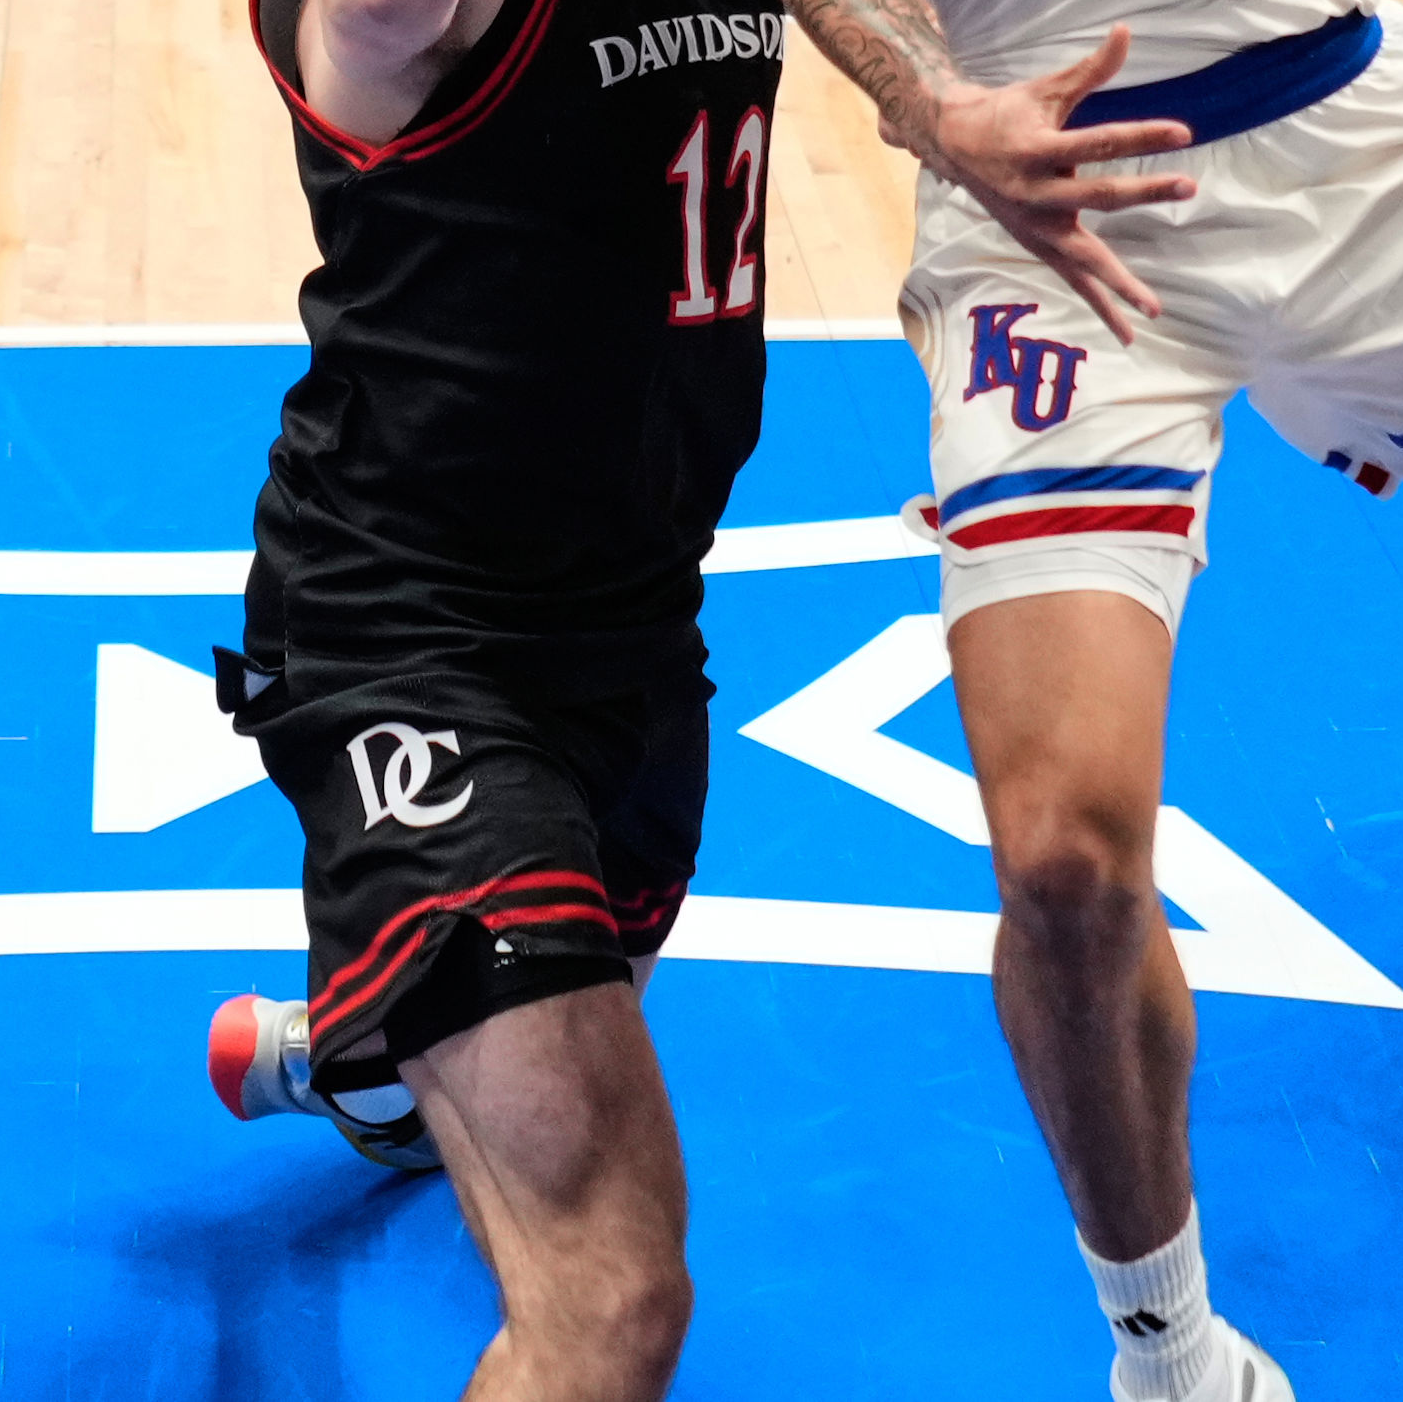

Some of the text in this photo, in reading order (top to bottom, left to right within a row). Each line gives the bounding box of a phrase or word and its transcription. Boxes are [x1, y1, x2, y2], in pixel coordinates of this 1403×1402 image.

[589, 12, 786, 88] DAVIDSO
[666, 104, 767, 326] 12
[963, 303, 1088, 432] KU
[346, 721, 474, 831] DC
